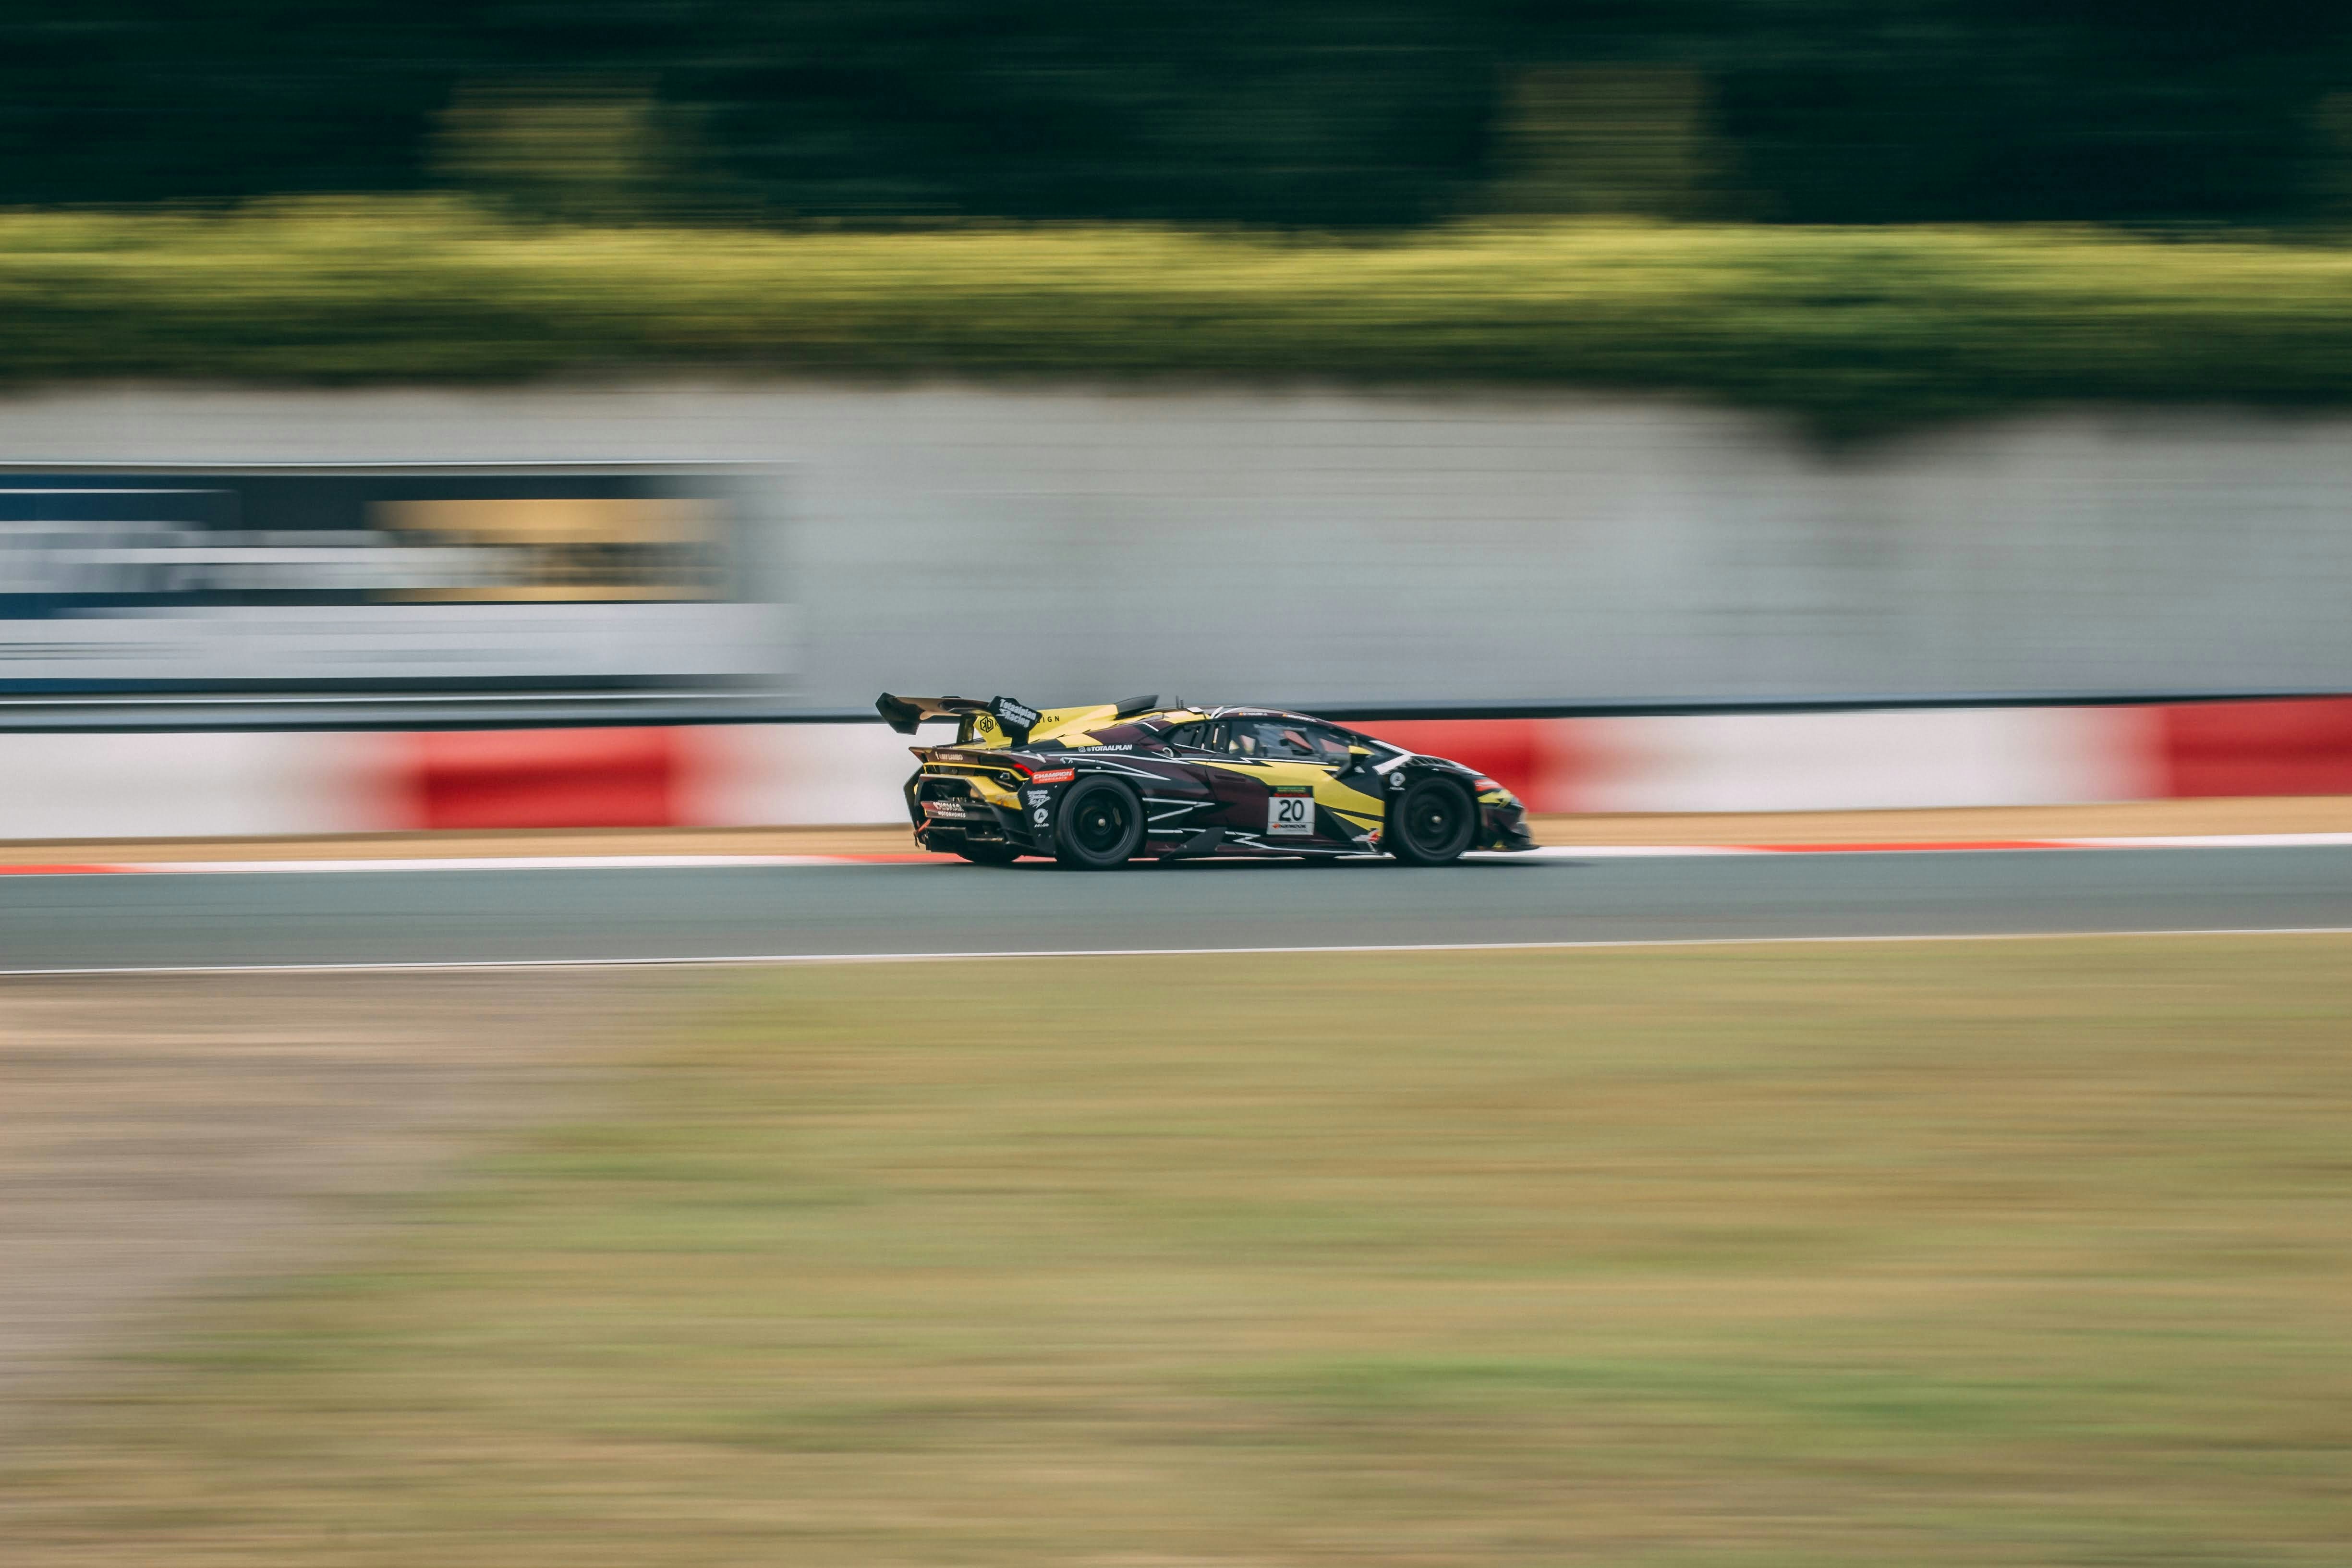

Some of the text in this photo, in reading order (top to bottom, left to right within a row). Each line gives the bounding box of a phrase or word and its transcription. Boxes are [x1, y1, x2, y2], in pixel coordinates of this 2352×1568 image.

[995, 708, 1031, 728] Racing
[999, 699, 1037, 720] Totaalplan
[1033, 771, 1072, 779] CHAMPION
[1278, 799, 1304, 822] 20
